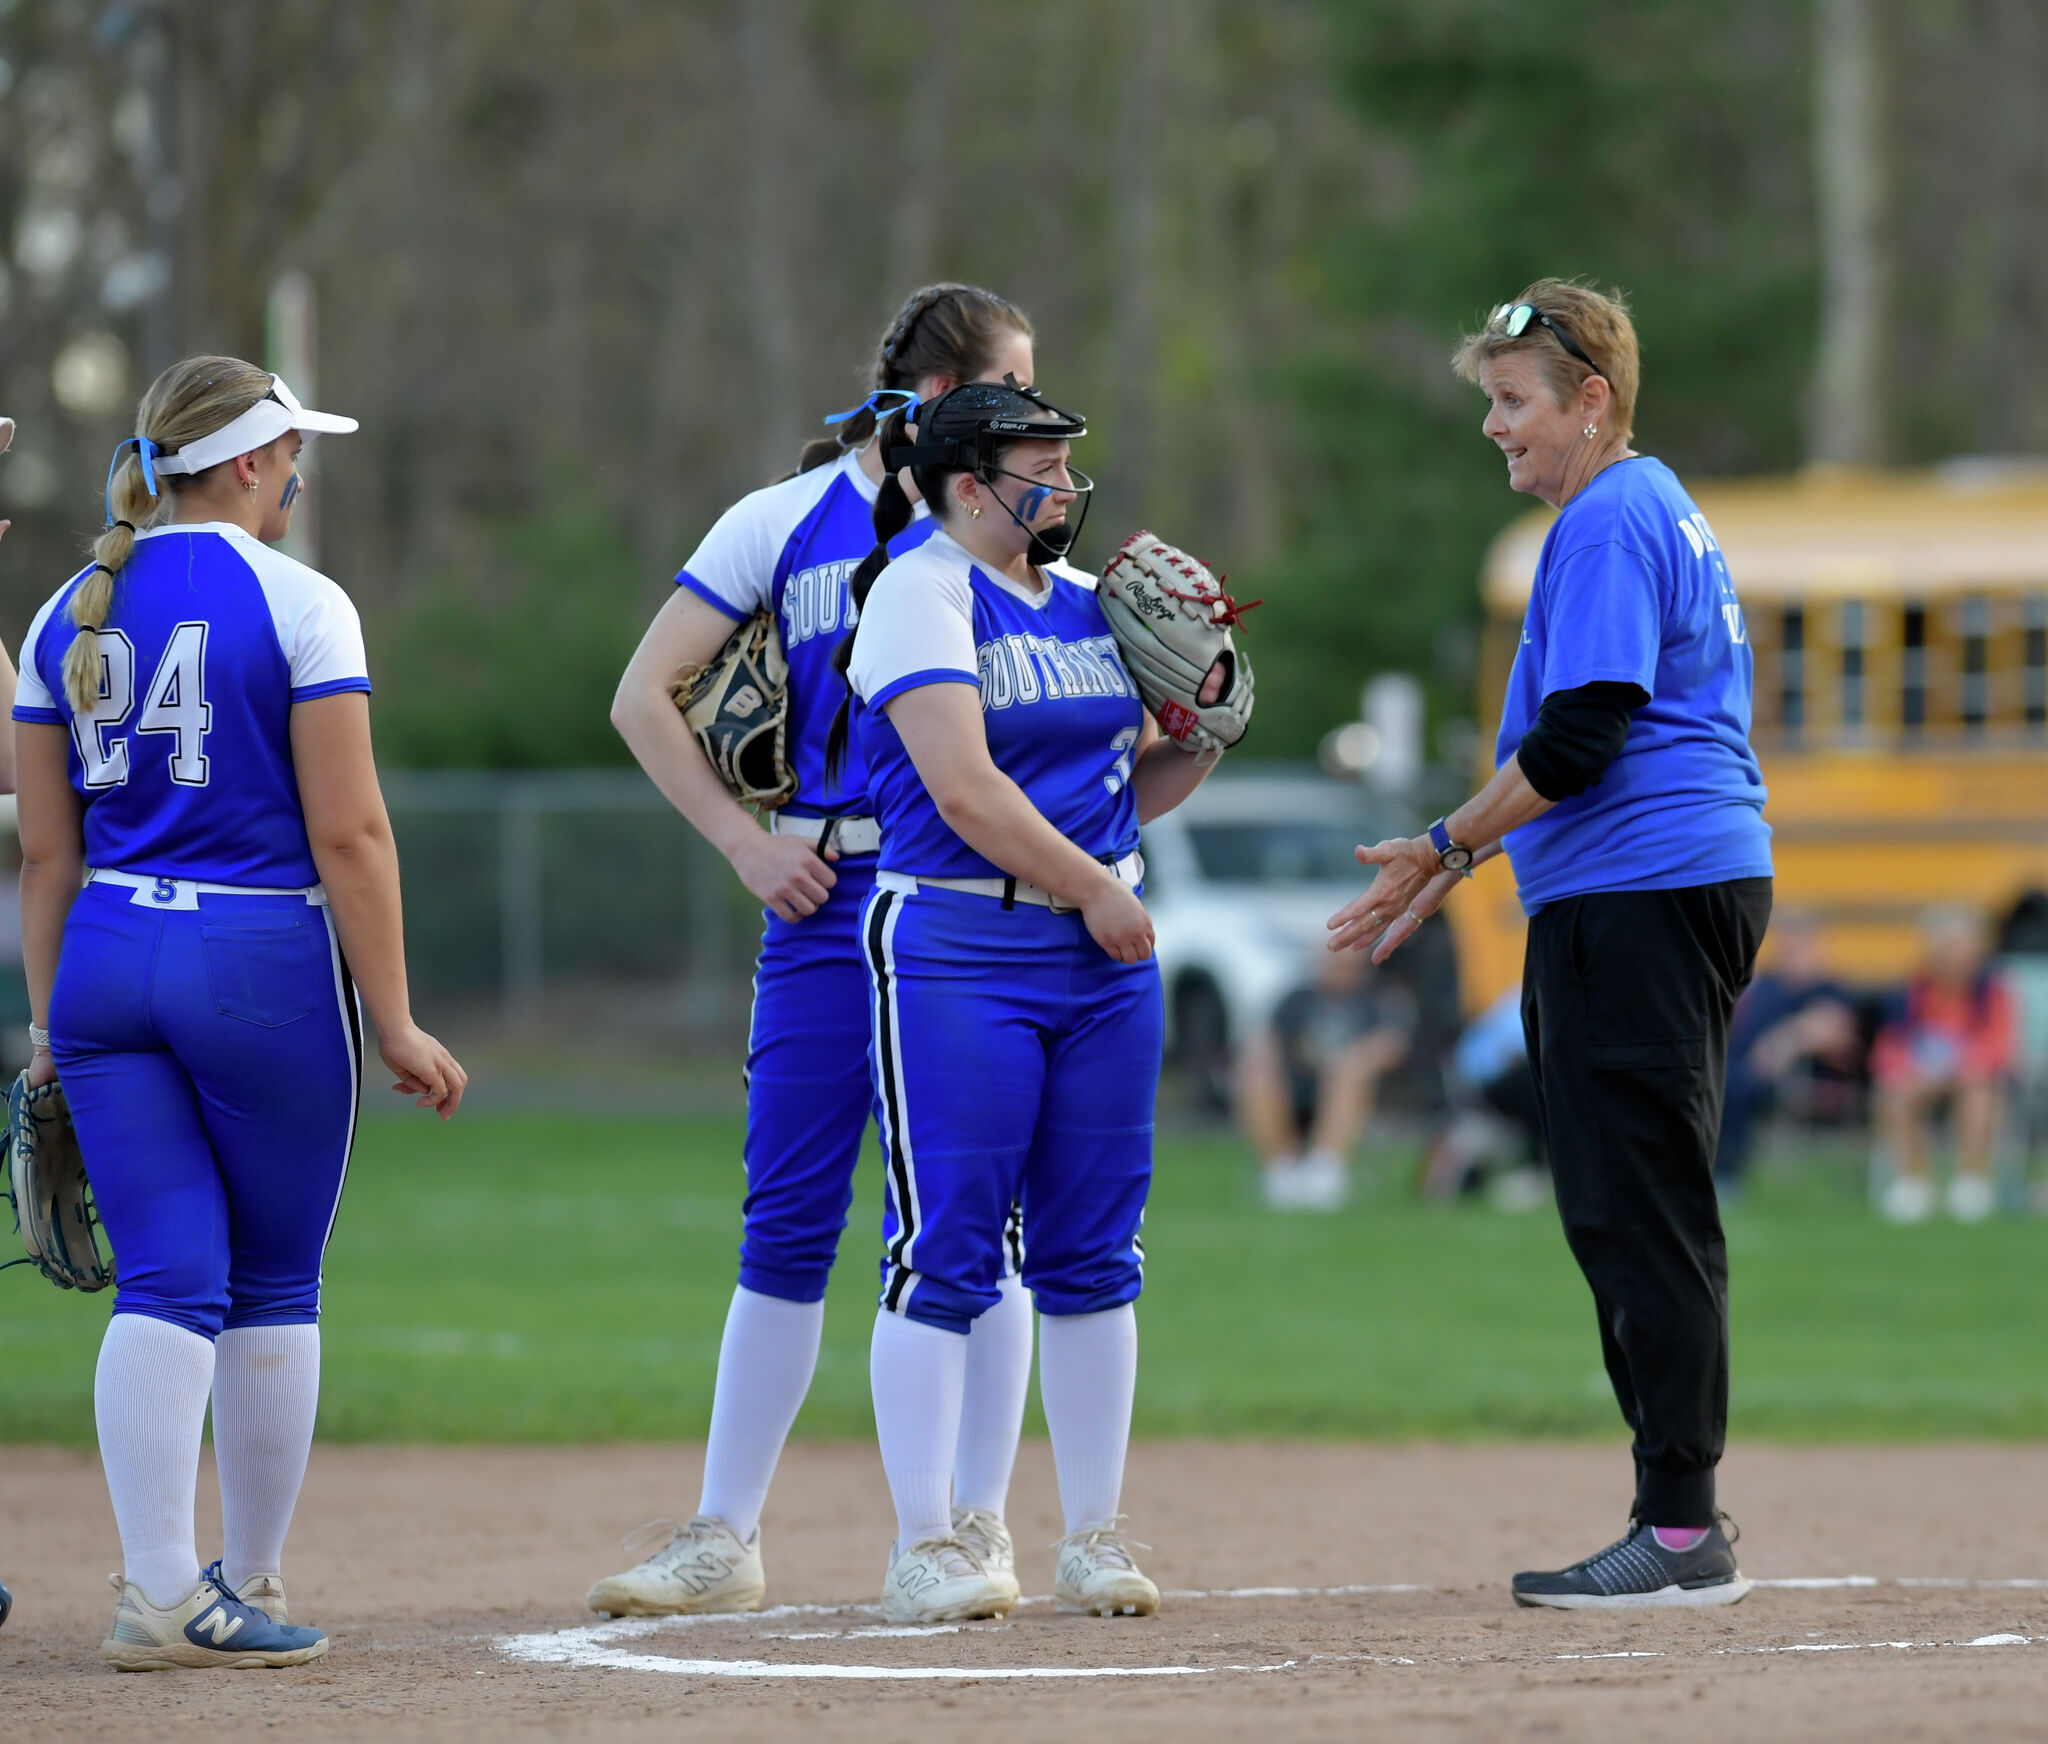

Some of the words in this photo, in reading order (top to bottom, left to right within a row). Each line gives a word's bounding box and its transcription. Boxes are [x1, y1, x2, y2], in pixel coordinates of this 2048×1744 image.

[1125, 580, 1176, 621] Rawlings
[71, 620, 212, 789] 24
[151, 877, 178, 904] S
[195, 1606, 245, 1645] N
